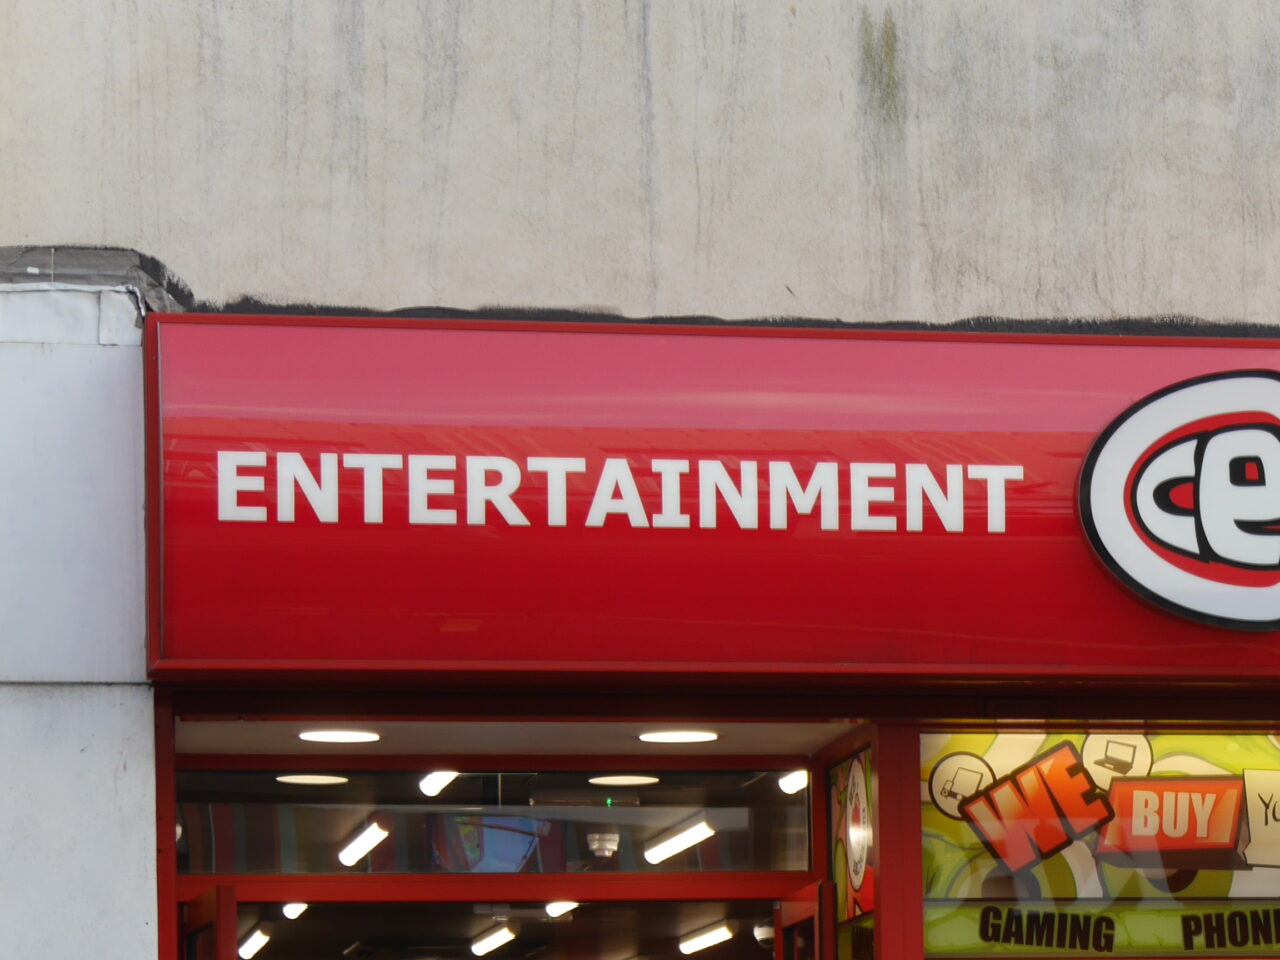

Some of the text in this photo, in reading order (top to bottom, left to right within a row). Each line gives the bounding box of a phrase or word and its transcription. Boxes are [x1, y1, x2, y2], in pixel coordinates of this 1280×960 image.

[216, 450, 1025, 533] ENTERTAINMENT
[965, 742, 1112, 873] WE
[1131, 789, 1217, 839] BUY
[978, 904, 1117, 953] GAMING
